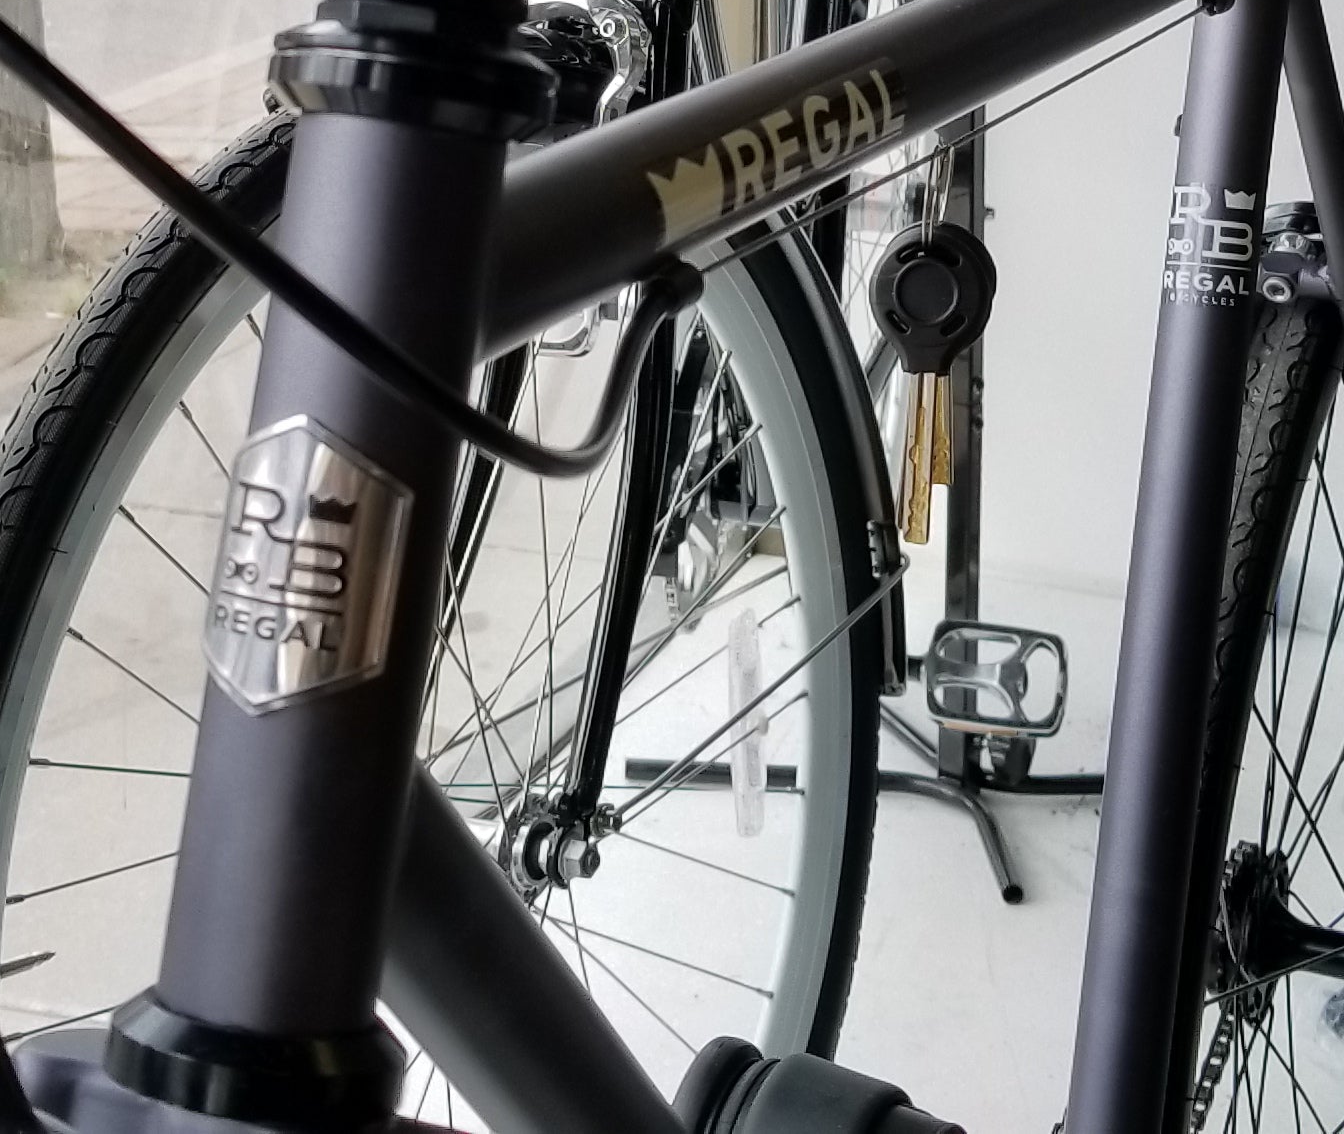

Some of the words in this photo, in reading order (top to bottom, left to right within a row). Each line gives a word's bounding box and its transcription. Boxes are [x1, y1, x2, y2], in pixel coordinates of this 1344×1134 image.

[721, 69, 905, 211] REGAL
[1164, 270, 1250, 296] REGAL
[213, 604, 342, 653] REGAL
